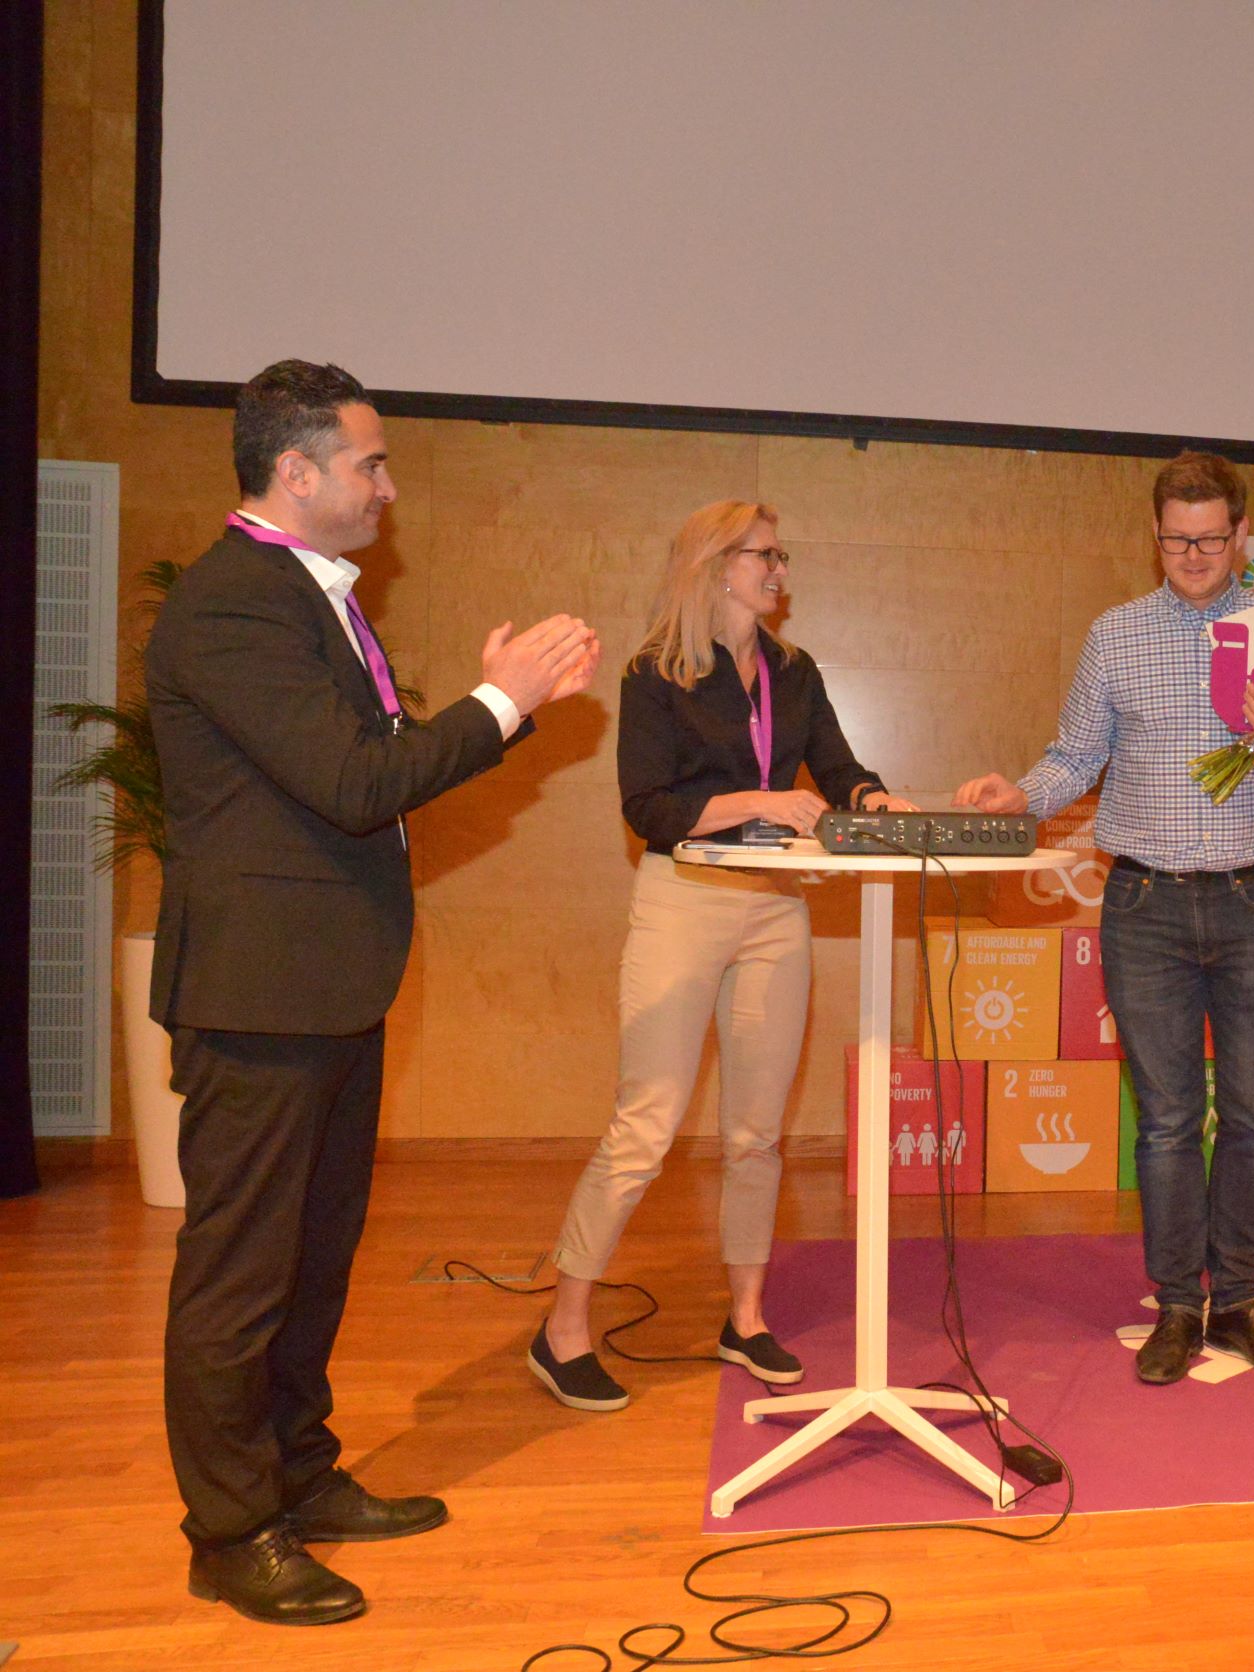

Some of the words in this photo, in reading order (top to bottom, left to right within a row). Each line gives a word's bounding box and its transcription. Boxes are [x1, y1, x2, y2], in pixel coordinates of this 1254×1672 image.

[1045, 836, 1065, 848] AND
[943, 935, 956, 964] 7
[967, 937, 1026, 949] AFFORDABLE
[1027, 937, 1047, 949] AND
[1076, 936, 1091, 965] 8
[966, 953, 998, 965] CLEAN
[1000, 953, 1038, 966] ENERGY
[1029, 1069, 1054, 1082] ZERO
[1004, 1069, 1018, 1098] 2
[1029, 1085, 1067, 1097] HUNGER
